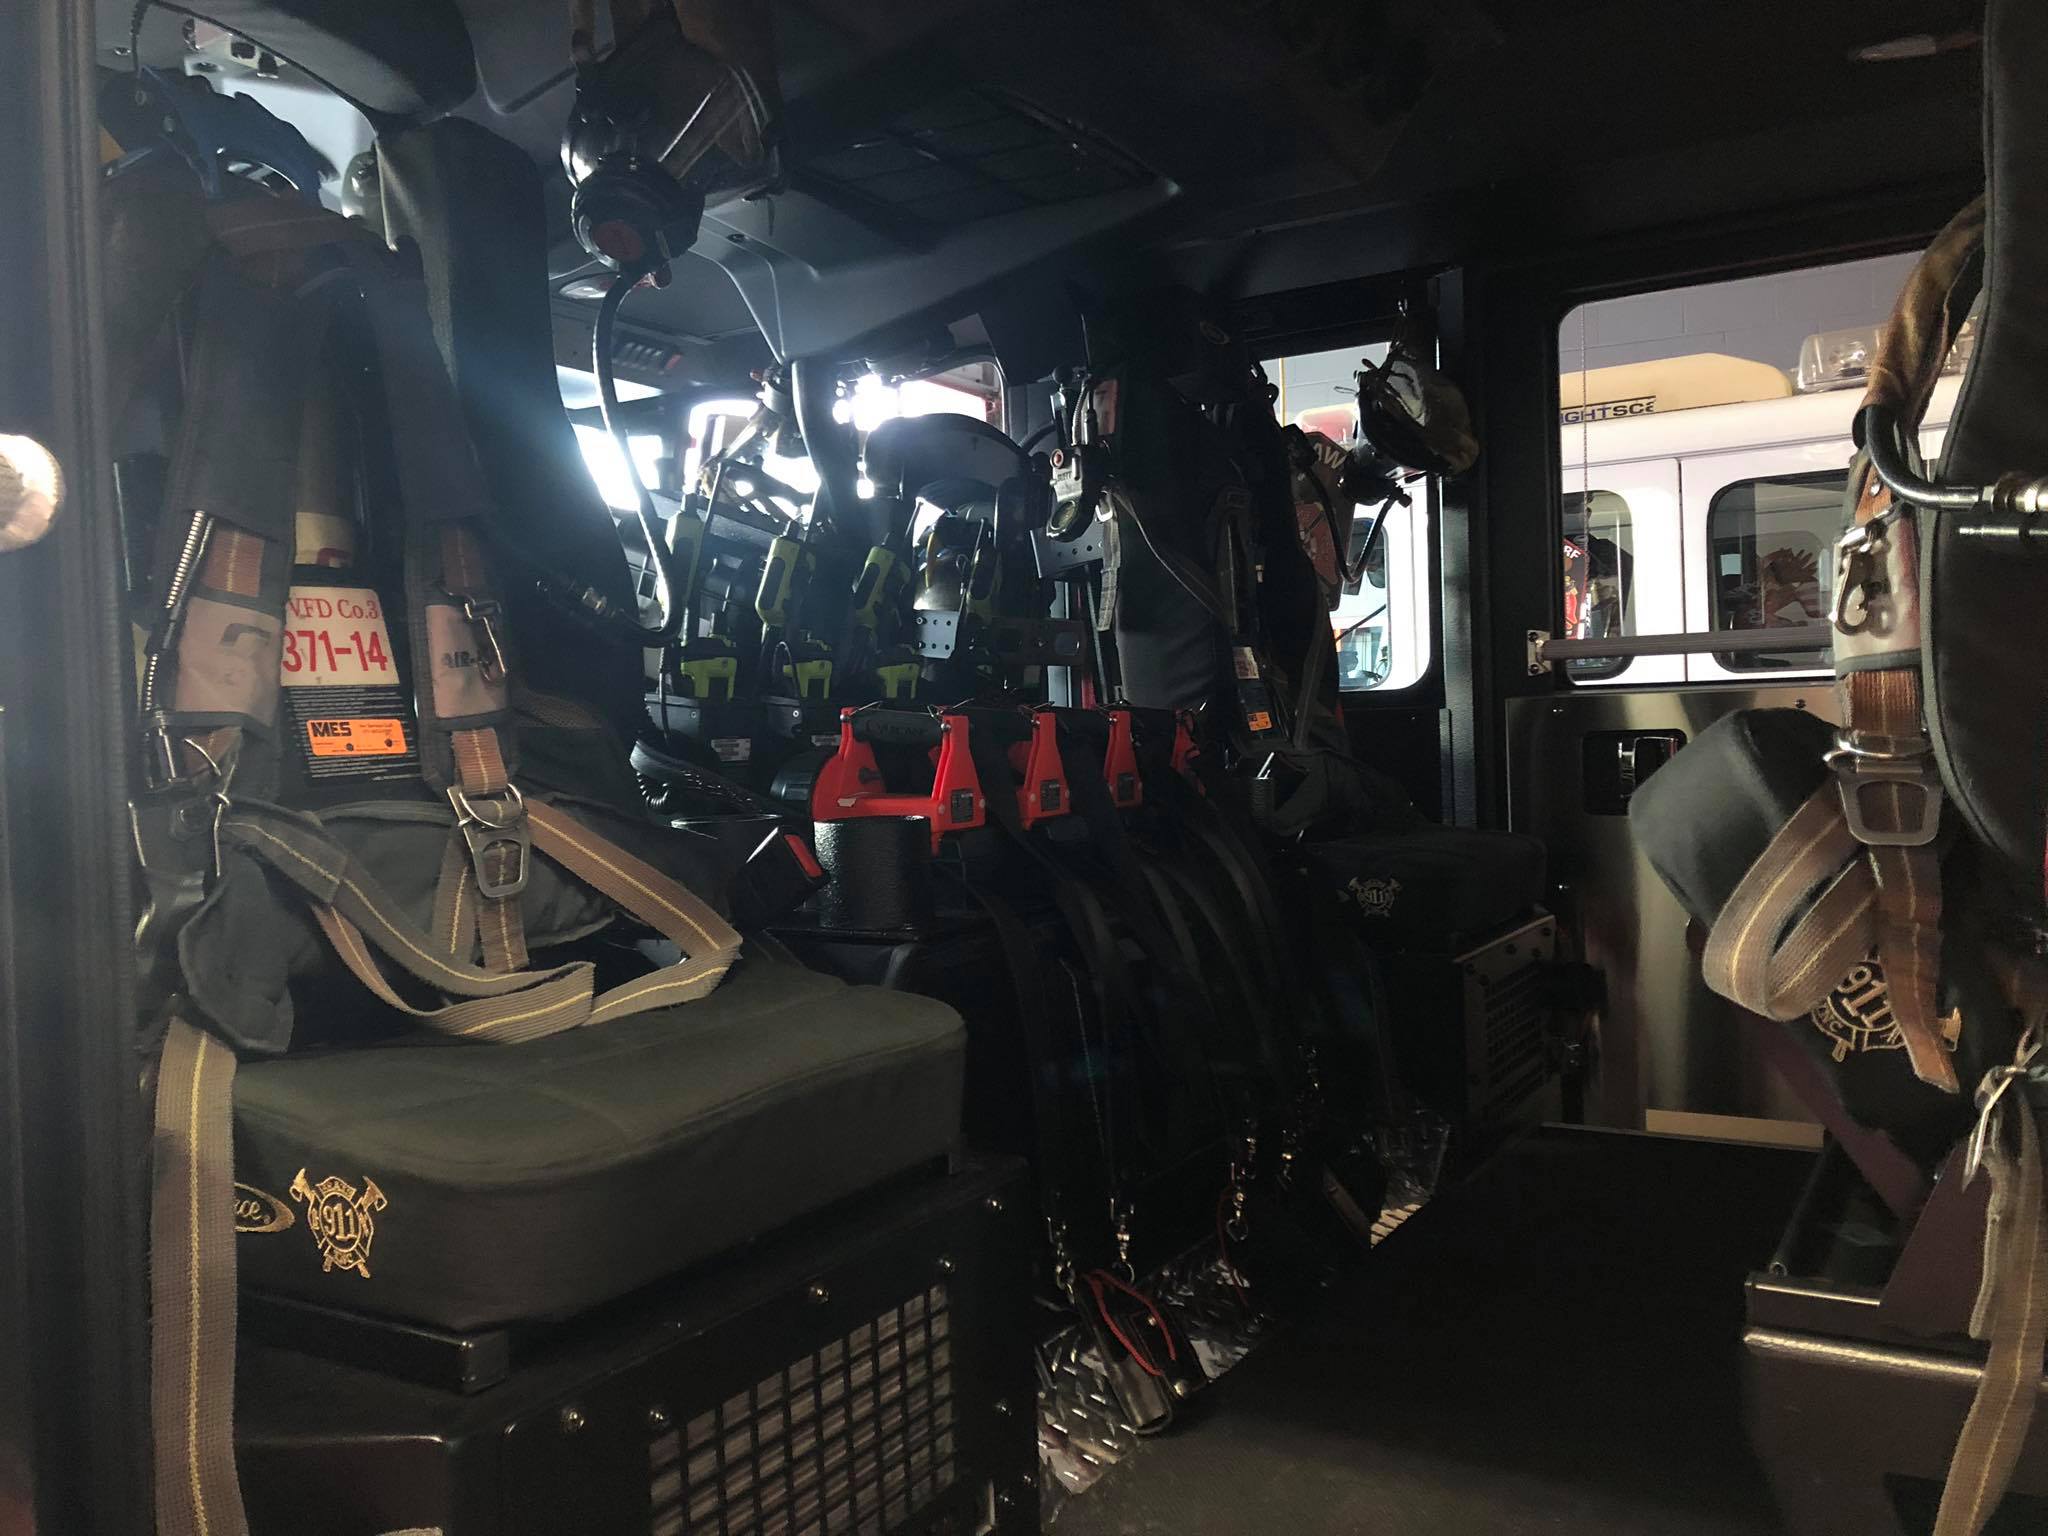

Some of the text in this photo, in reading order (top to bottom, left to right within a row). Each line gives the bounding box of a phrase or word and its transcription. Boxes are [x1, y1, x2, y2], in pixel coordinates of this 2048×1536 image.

[282, 630, 388, 672] 371-14
[310, 721, 352, 737] MES
[1836, 965, 1892, 1029] 911
[323, 1203, 357, 1240] 911
